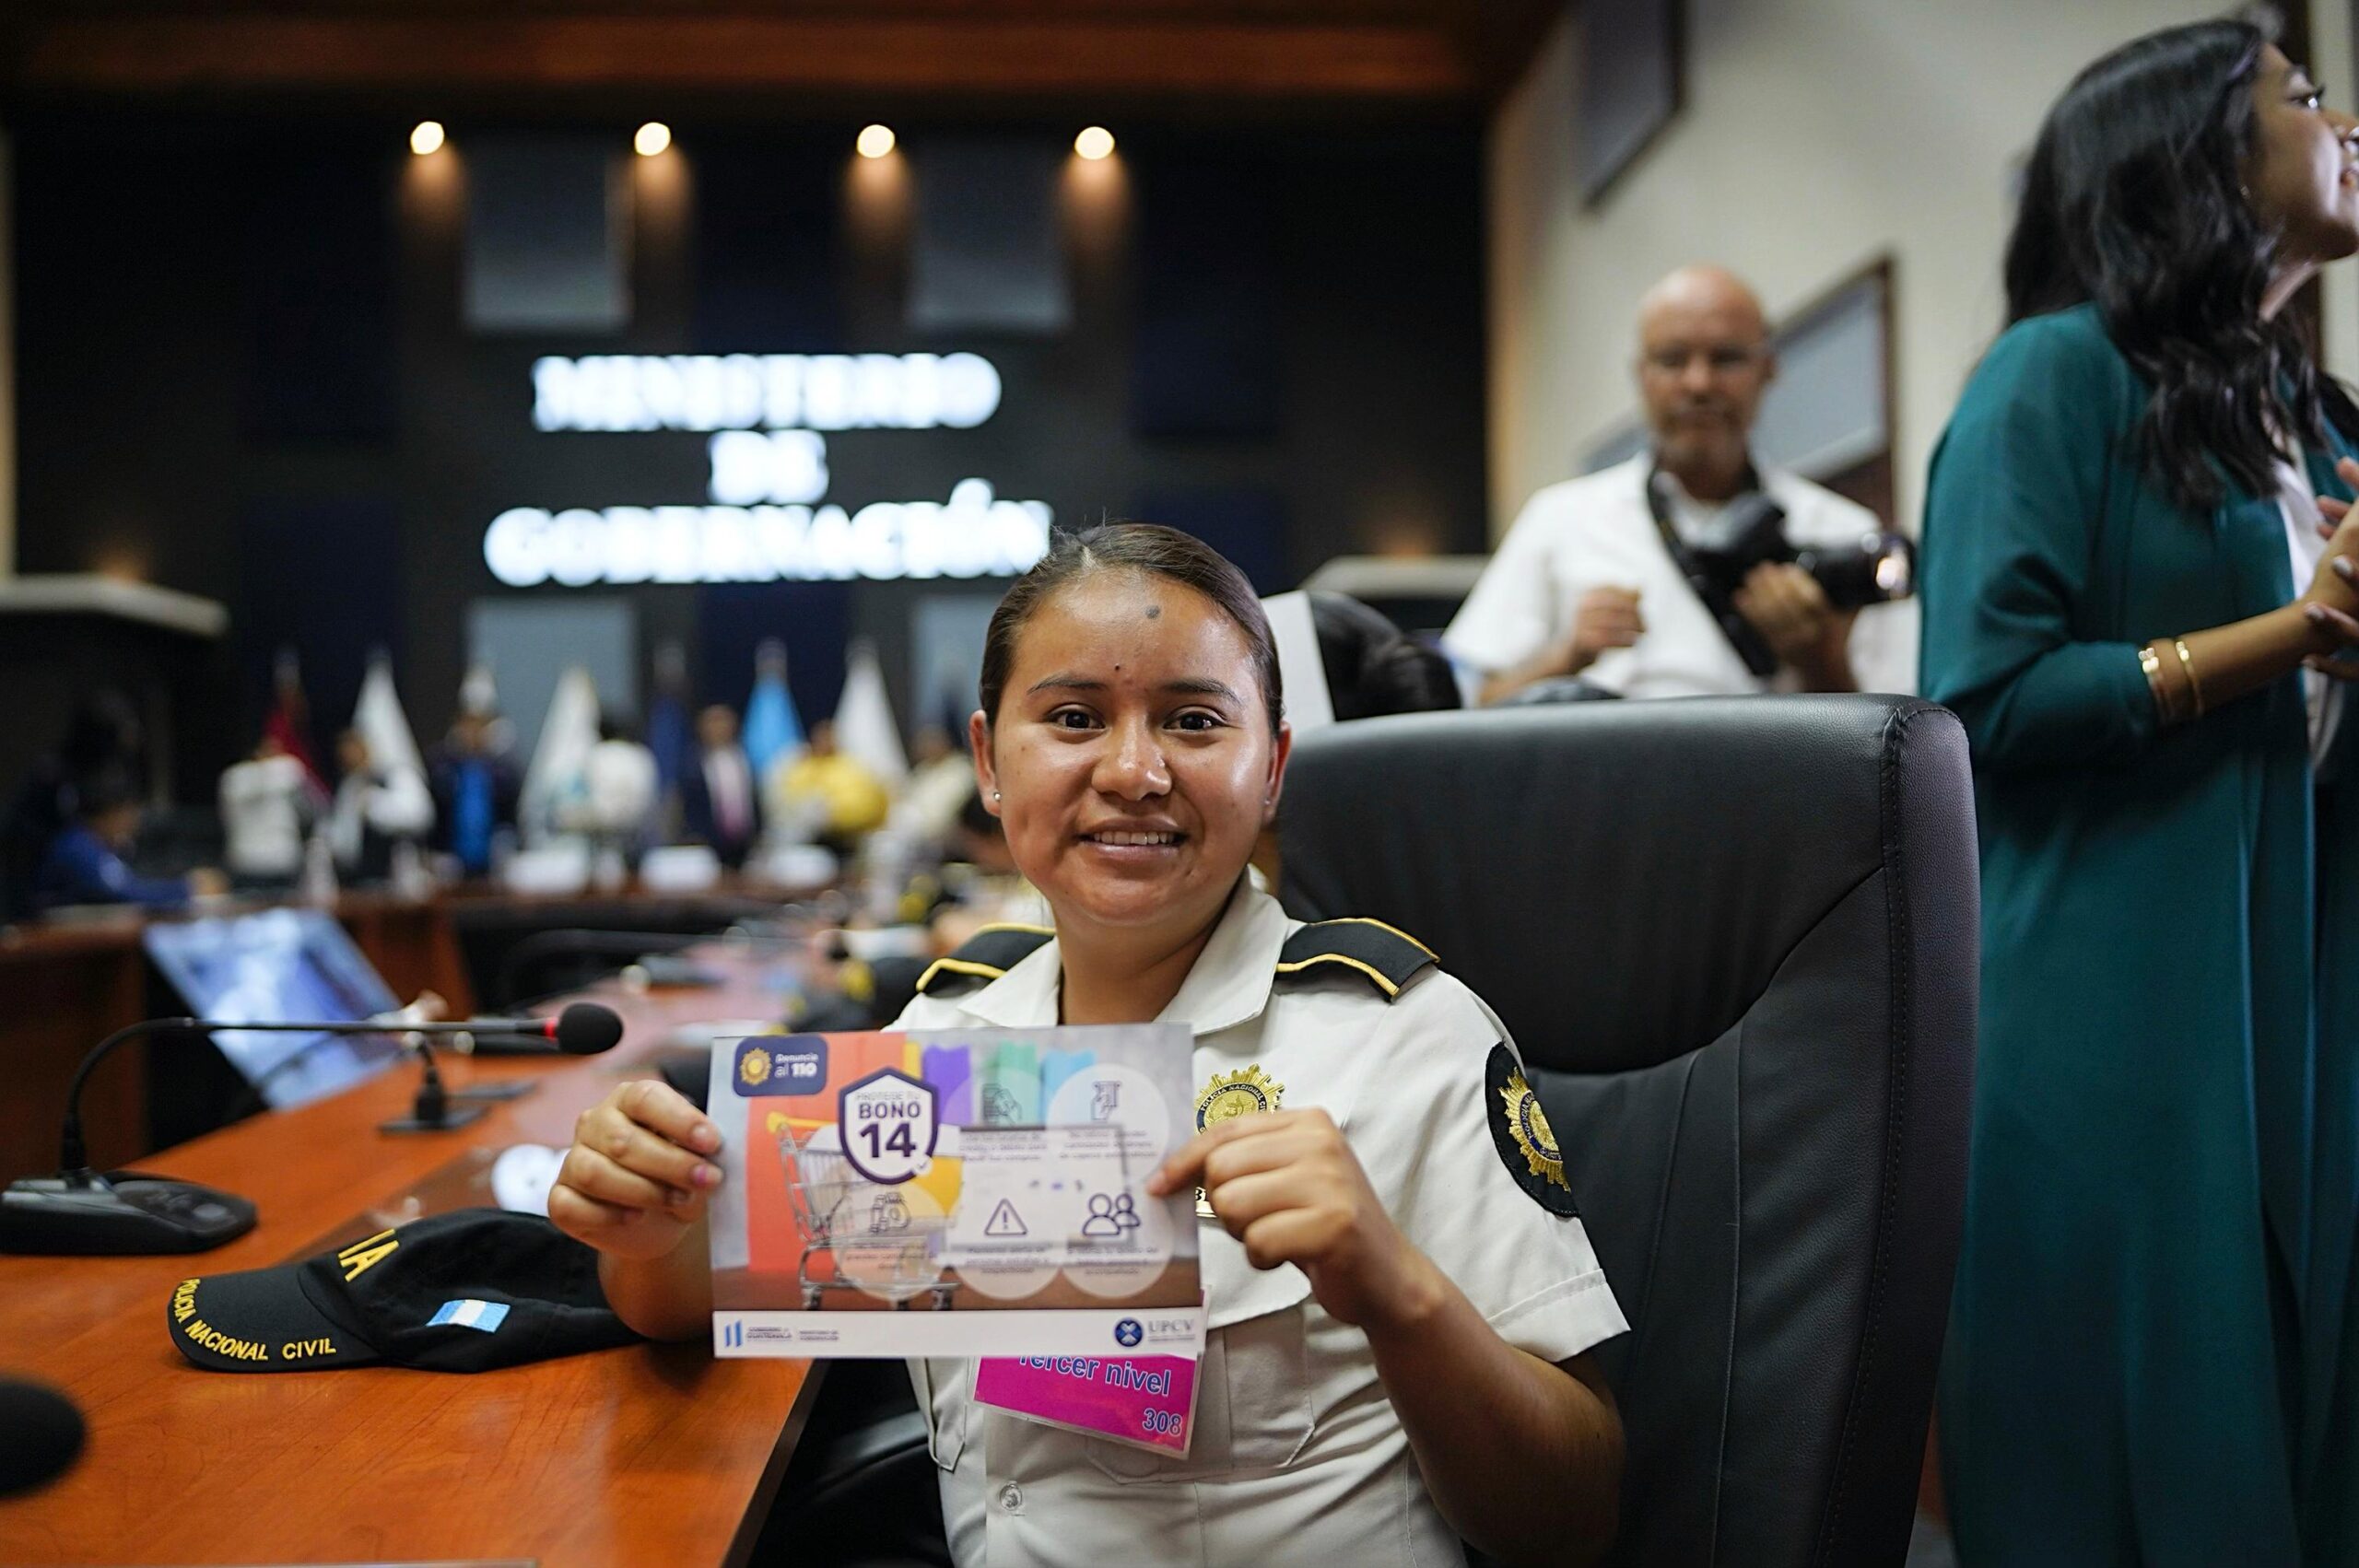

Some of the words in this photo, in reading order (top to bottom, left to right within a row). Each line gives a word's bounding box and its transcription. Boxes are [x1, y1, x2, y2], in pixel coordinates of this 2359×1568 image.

[709, 429, 829, 505] DE
[775, 1062, 789, 1078] al
[792, 1062, 817, 1077] 110
[860, 1101, 921, 1118] BONO
[861, 1122, 917, 1158] 14
[184, 1319, 269, 1361] NACIONAL
[282, 1338, 336, 1360] CIVIL
[1148, 1319, 1194, 1333] UPCV
[1105, 1361, 1172, 1397] nivel
[1143, 1407, 1182, 1437] 308
